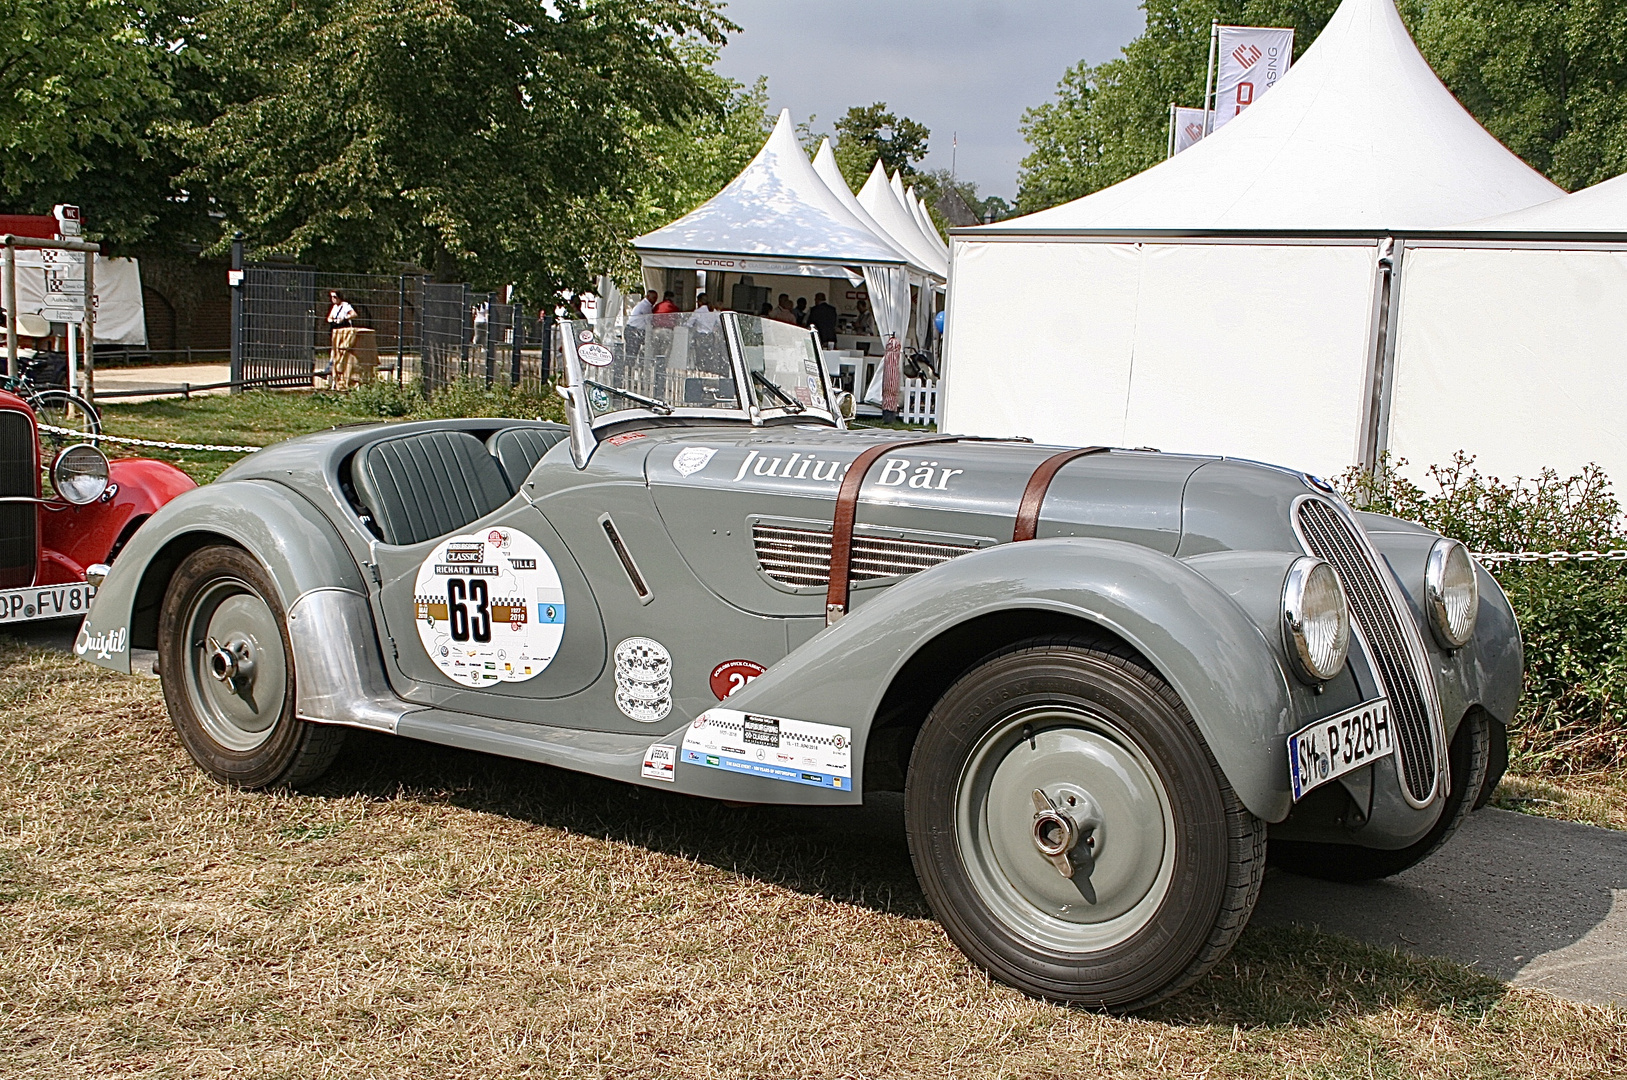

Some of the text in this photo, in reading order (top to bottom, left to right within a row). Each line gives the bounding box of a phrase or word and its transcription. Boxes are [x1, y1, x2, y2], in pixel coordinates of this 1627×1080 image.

[66, 208, 76, 218] WC
[875, 458, 964, 491] Bär
[446, 552, 479, 561] CLASSIC
[436, 566, 498, 574] RICHARD MILLE
[37, 589, 65, 615] FV
[447, 578, 492, 643] 63
